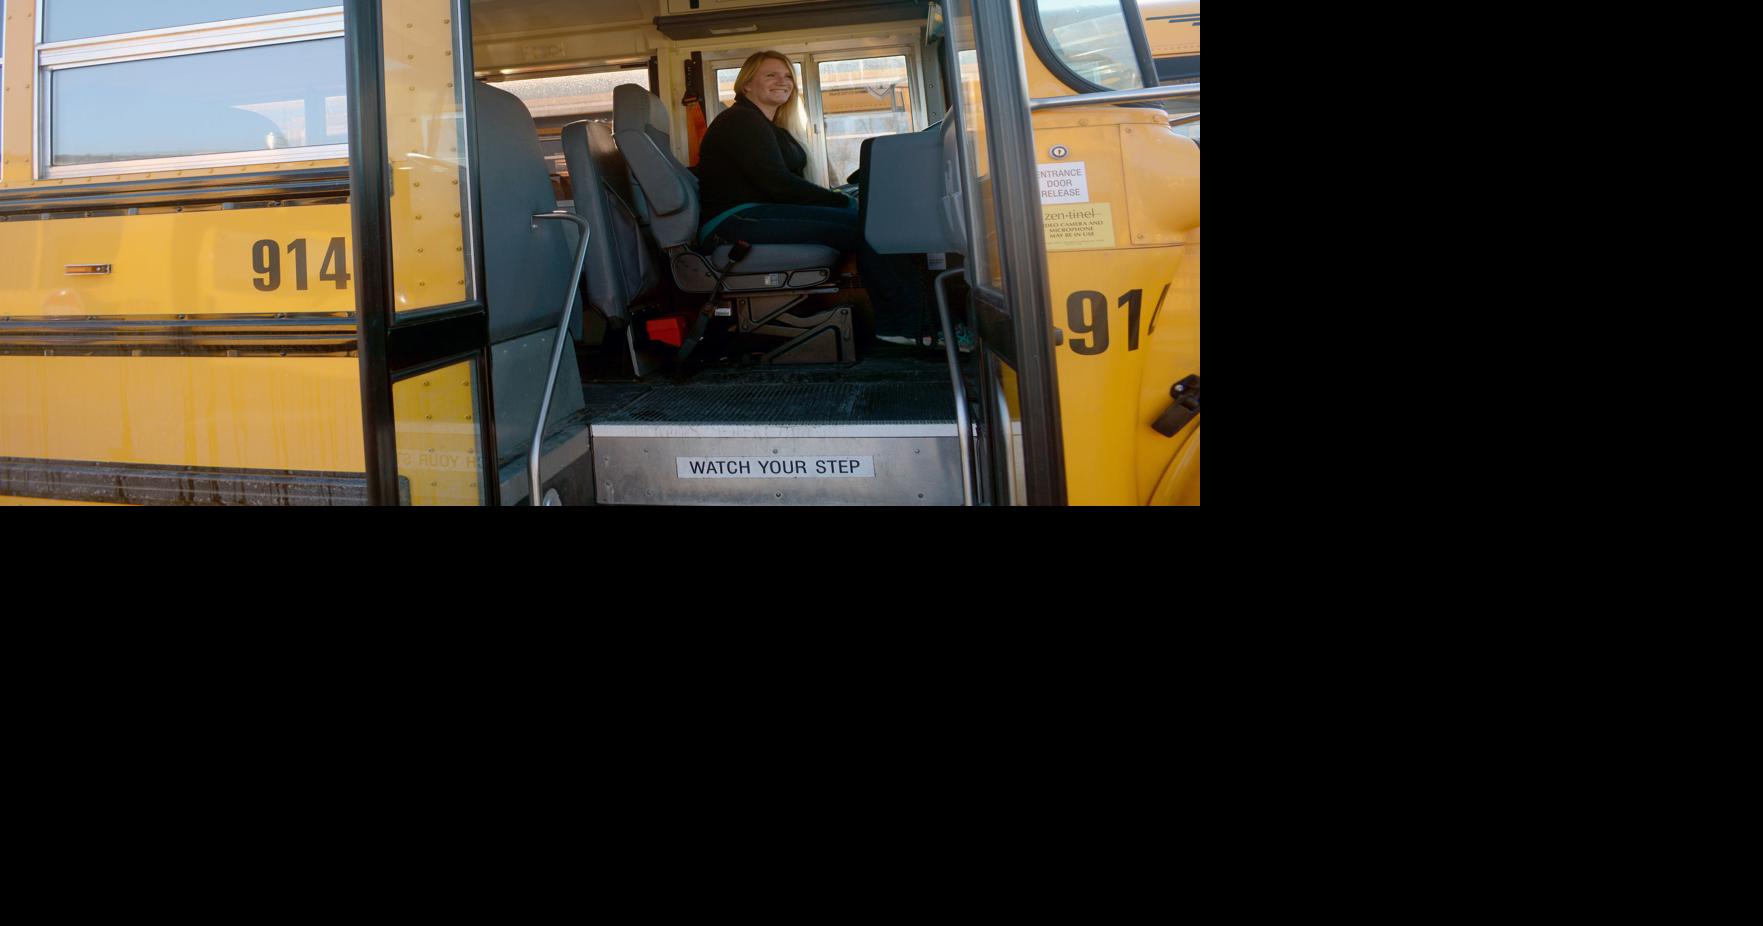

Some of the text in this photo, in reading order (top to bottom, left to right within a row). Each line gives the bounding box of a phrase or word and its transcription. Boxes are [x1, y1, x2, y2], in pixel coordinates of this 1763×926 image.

[1046, 179, 1073, 188] DOOR
[1041, 188, 1081, 198] RELEASE
[252, 236, 352, 292] 914
[1066, 282, 1171, 356] 91
[689, 459, 860, 475] WATCH YOUR STEP
